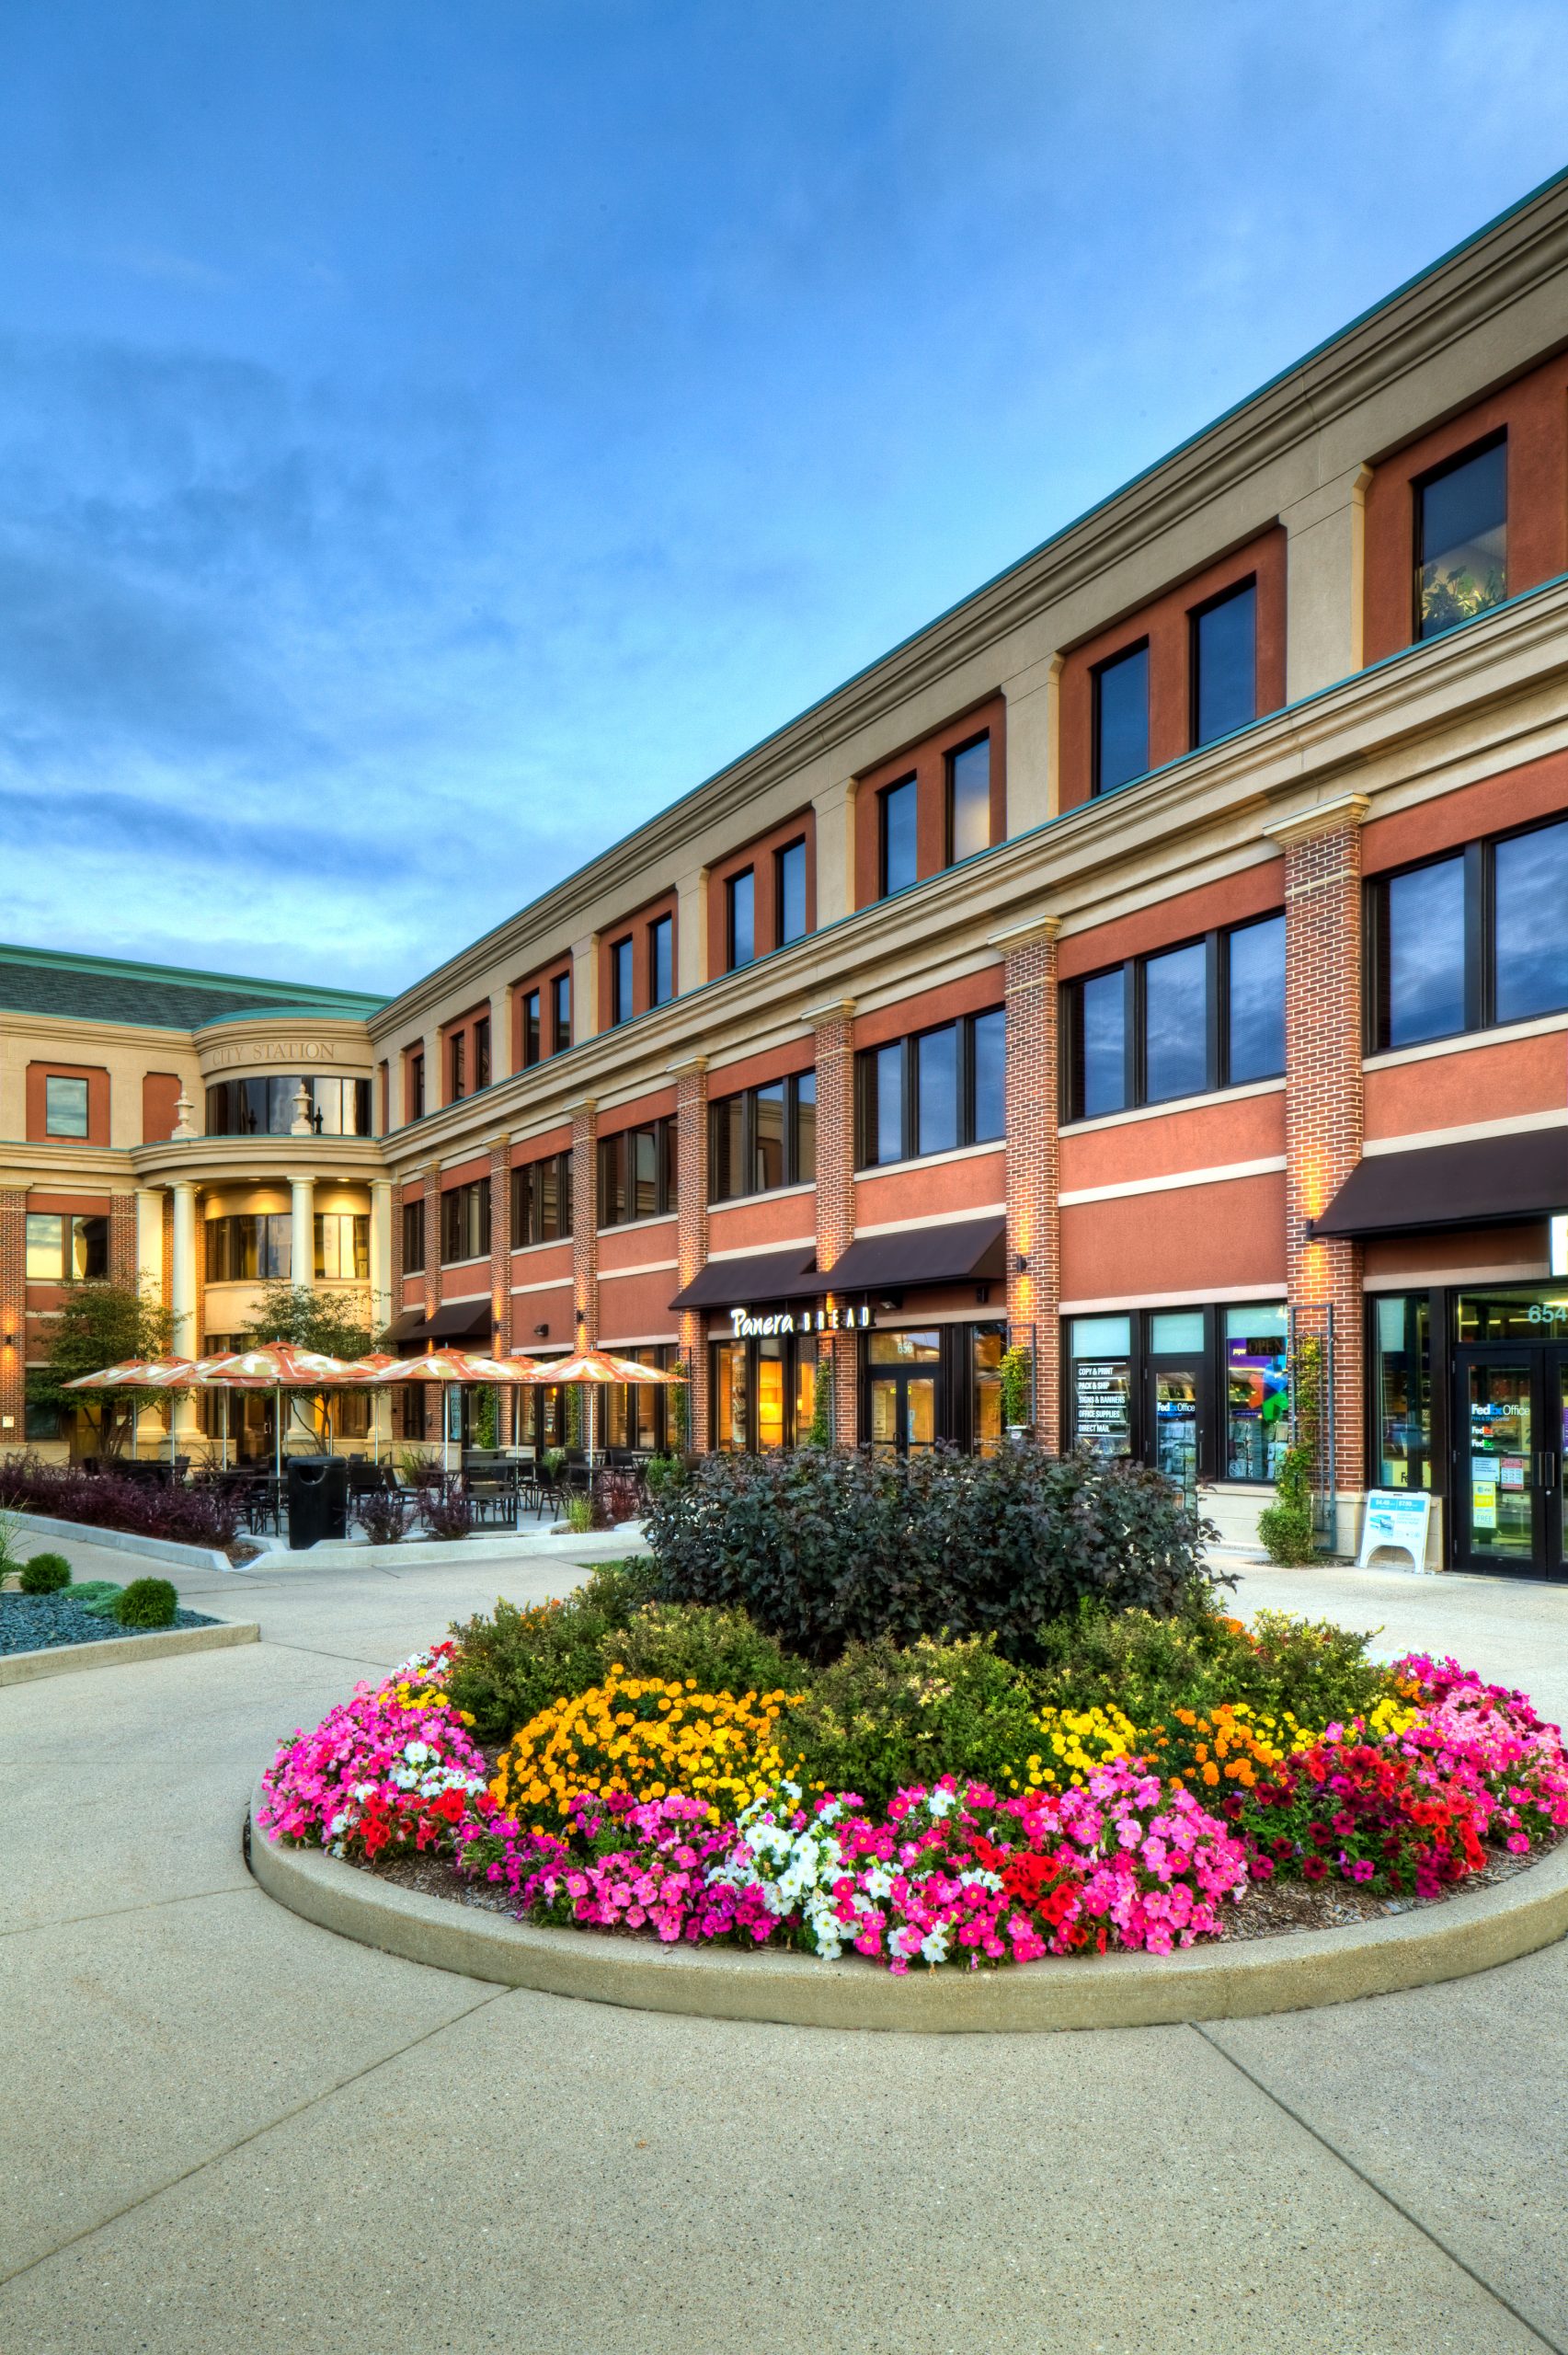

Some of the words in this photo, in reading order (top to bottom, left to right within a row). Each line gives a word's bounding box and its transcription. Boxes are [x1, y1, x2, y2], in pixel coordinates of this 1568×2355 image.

[212, 1046, 243, 1066] CITY
[253, 1042, 335, 1060] STATION
[1528, 1304, 1568, 1324] 654
[731, 1308, 794, 1338] Panera
[804, 1306, 870, 1331] BREAD
[898, 1342, 913, 1354] 656
[1249, 1338, 1283, 1354] OPEN
[1098, 1367, 1114, 1375] PRINT
[1079, 1382, 1092, 1390] PACK
[1471, 1404, 1502, 1415] FedEx
[1503, 1405, 1530, 1415] Office
[1471, 1426, 1494, 1434] FedEx
[1471, 1439, 1494, 1448] FedEx
